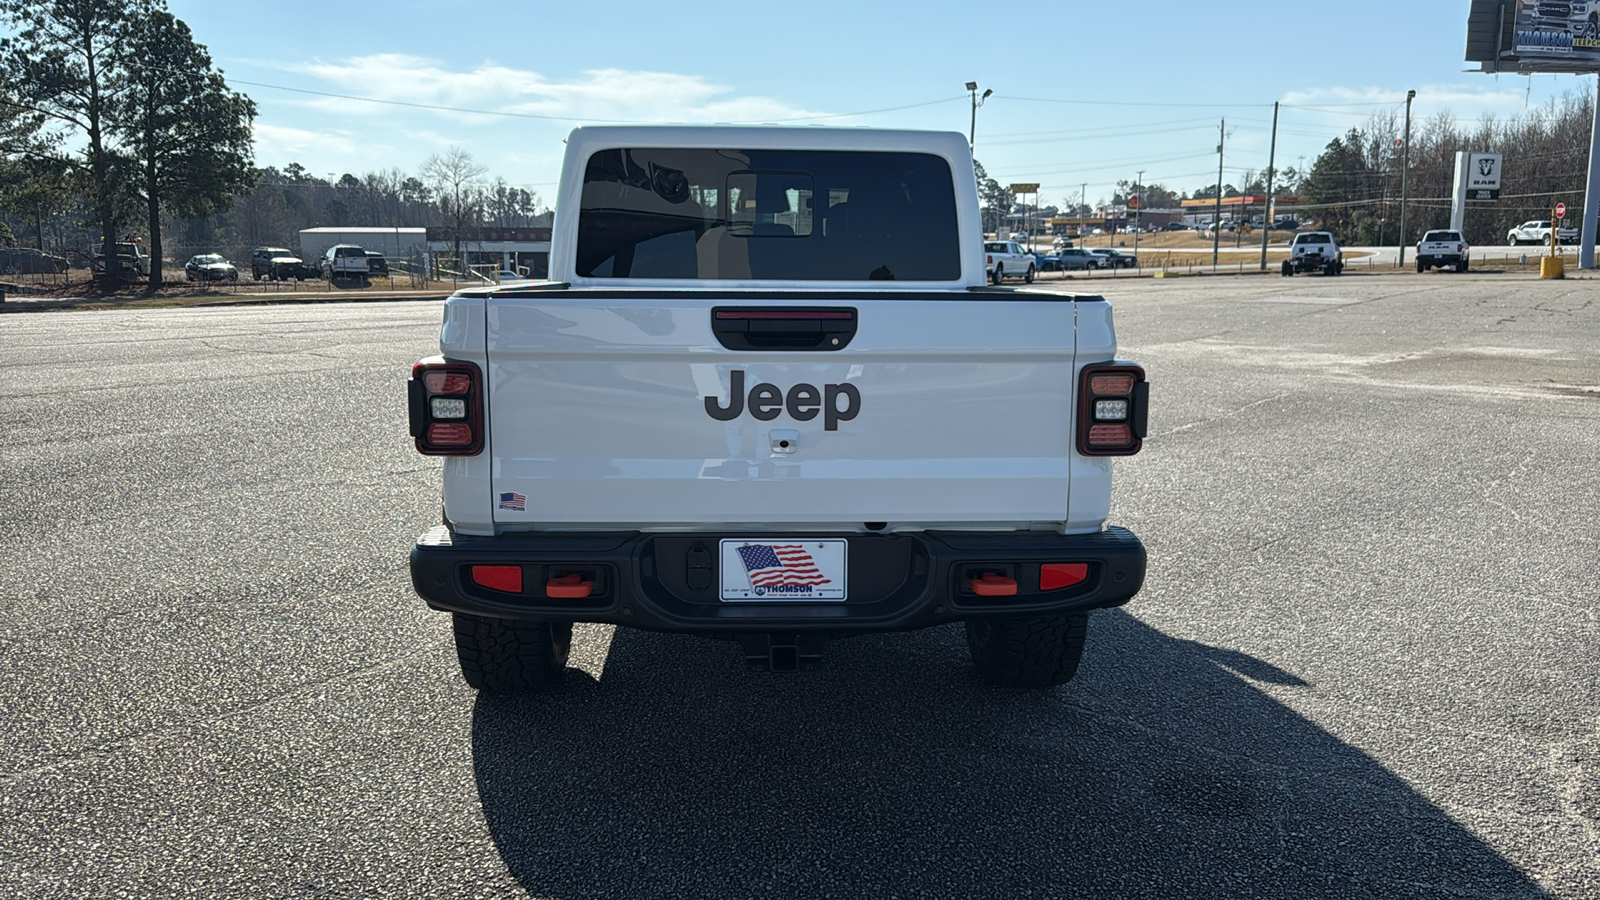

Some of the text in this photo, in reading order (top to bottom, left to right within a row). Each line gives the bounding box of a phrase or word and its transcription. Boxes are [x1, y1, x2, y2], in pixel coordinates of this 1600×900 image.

[1517, 31, 1573, 46] THOMSON
[704, 370, 861, 431] Jeep
[766, 585, 813, 593] THOMSON
